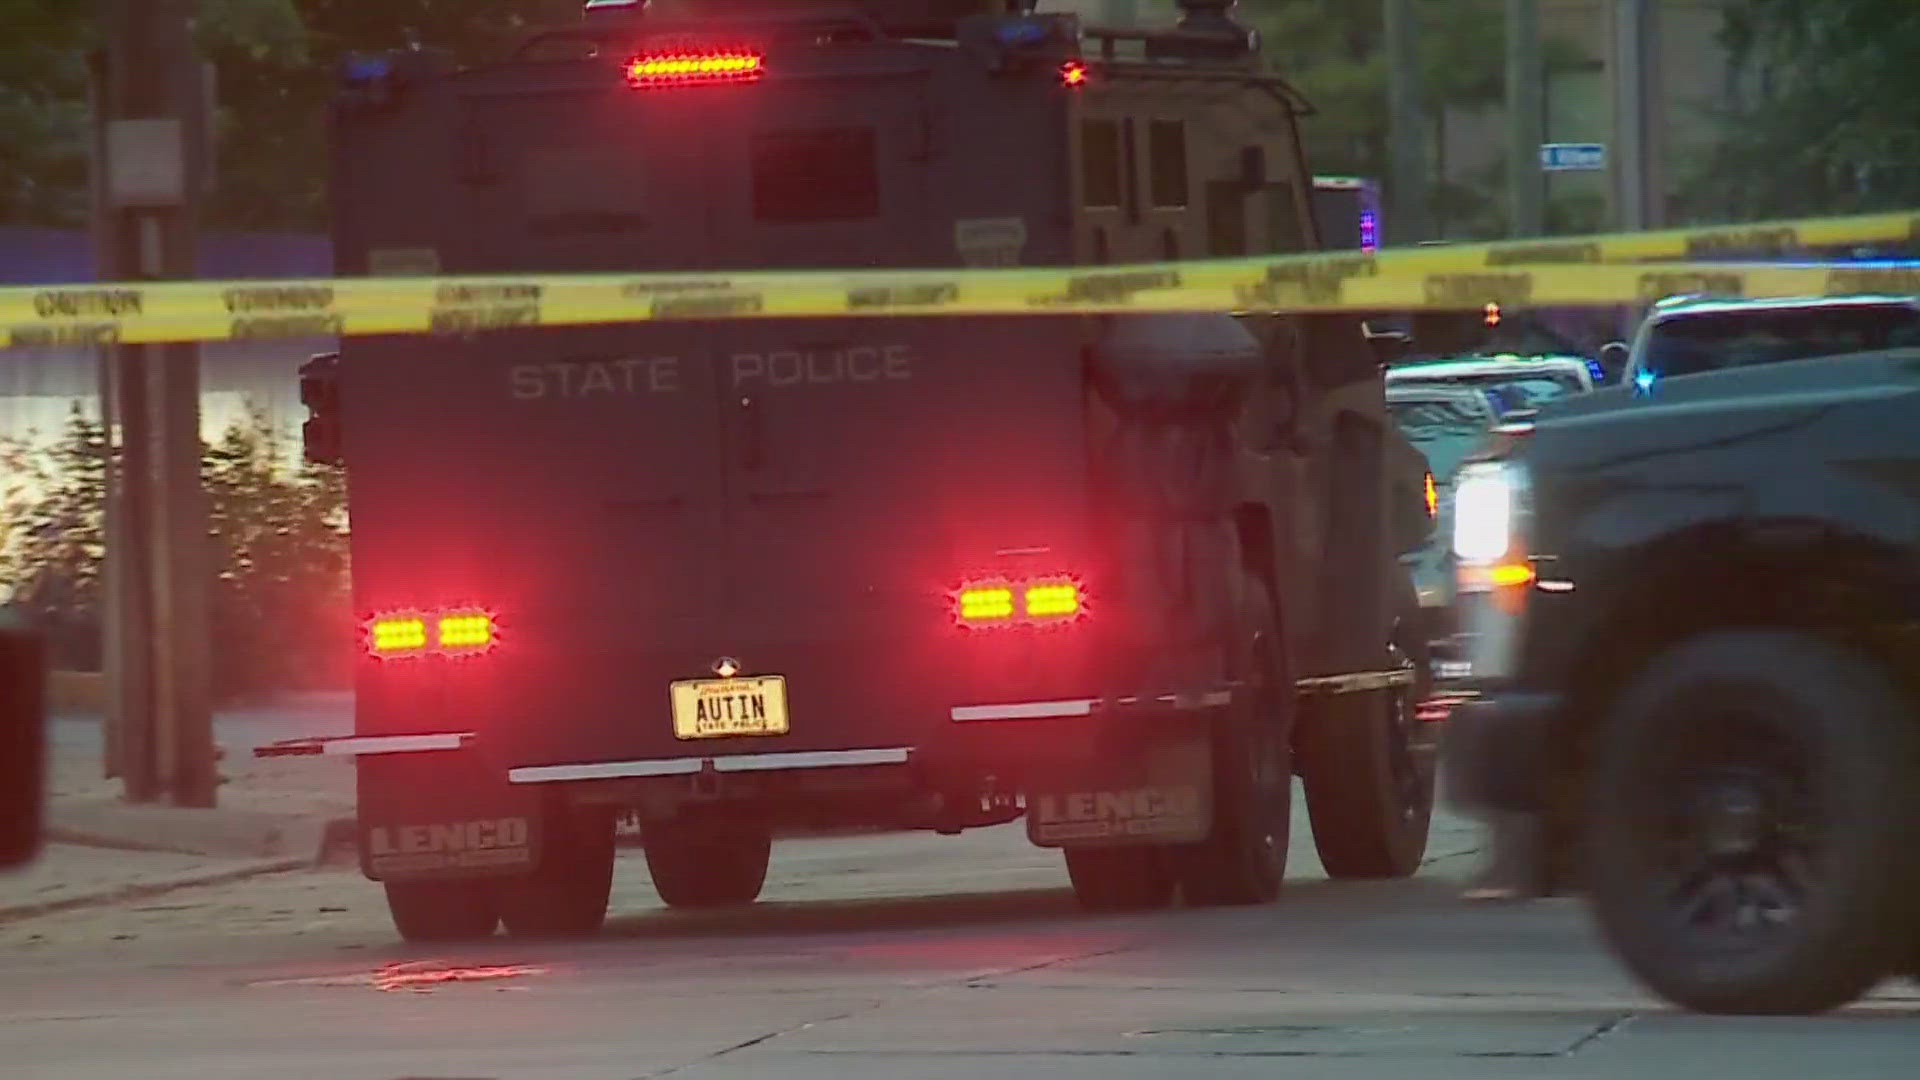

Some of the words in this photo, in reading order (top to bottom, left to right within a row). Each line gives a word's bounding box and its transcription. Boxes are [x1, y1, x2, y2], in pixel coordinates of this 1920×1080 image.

[510, 357, 678, 399] STATE
[731, 345, 912, 388] POLICE
[697, 694, 765, 721] AUTIN
[1039, 785, 1199, 823] LENCO
[371, 818, 528, 854] LENCO
